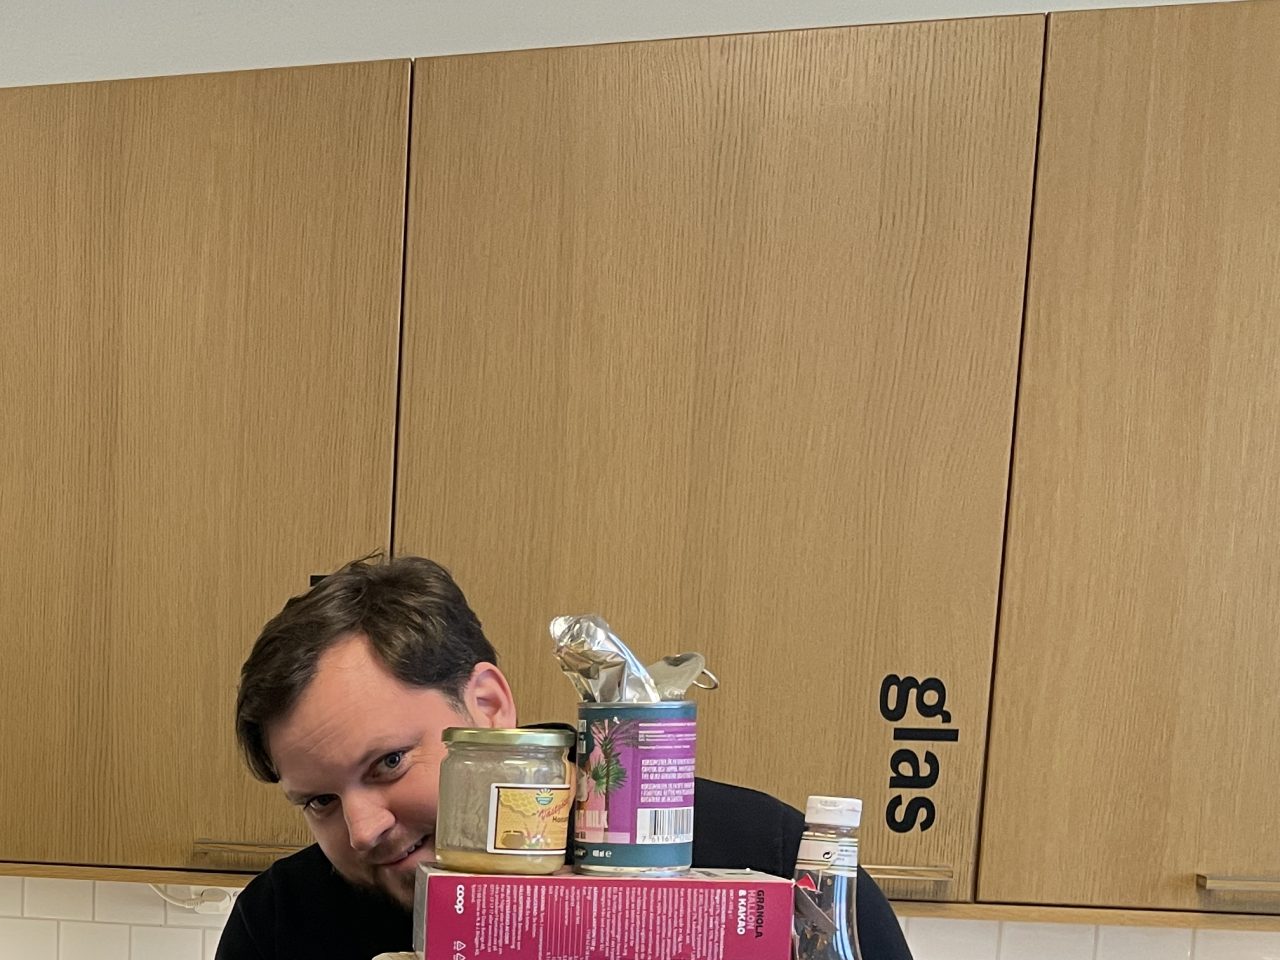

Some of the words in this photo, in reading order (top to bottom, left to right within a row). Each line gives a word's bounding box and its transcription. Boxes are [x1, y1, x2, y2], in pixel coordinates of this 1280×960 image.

[879, 673, 960, 834] glas
[454, 884, 465, 915] coop
[737, 889, 747, 897] &
[746, 889, 756, 930] HALLON
[736, 897, 747, 936] KAKAO
[754, 889, 765, 939] GRANOLA
